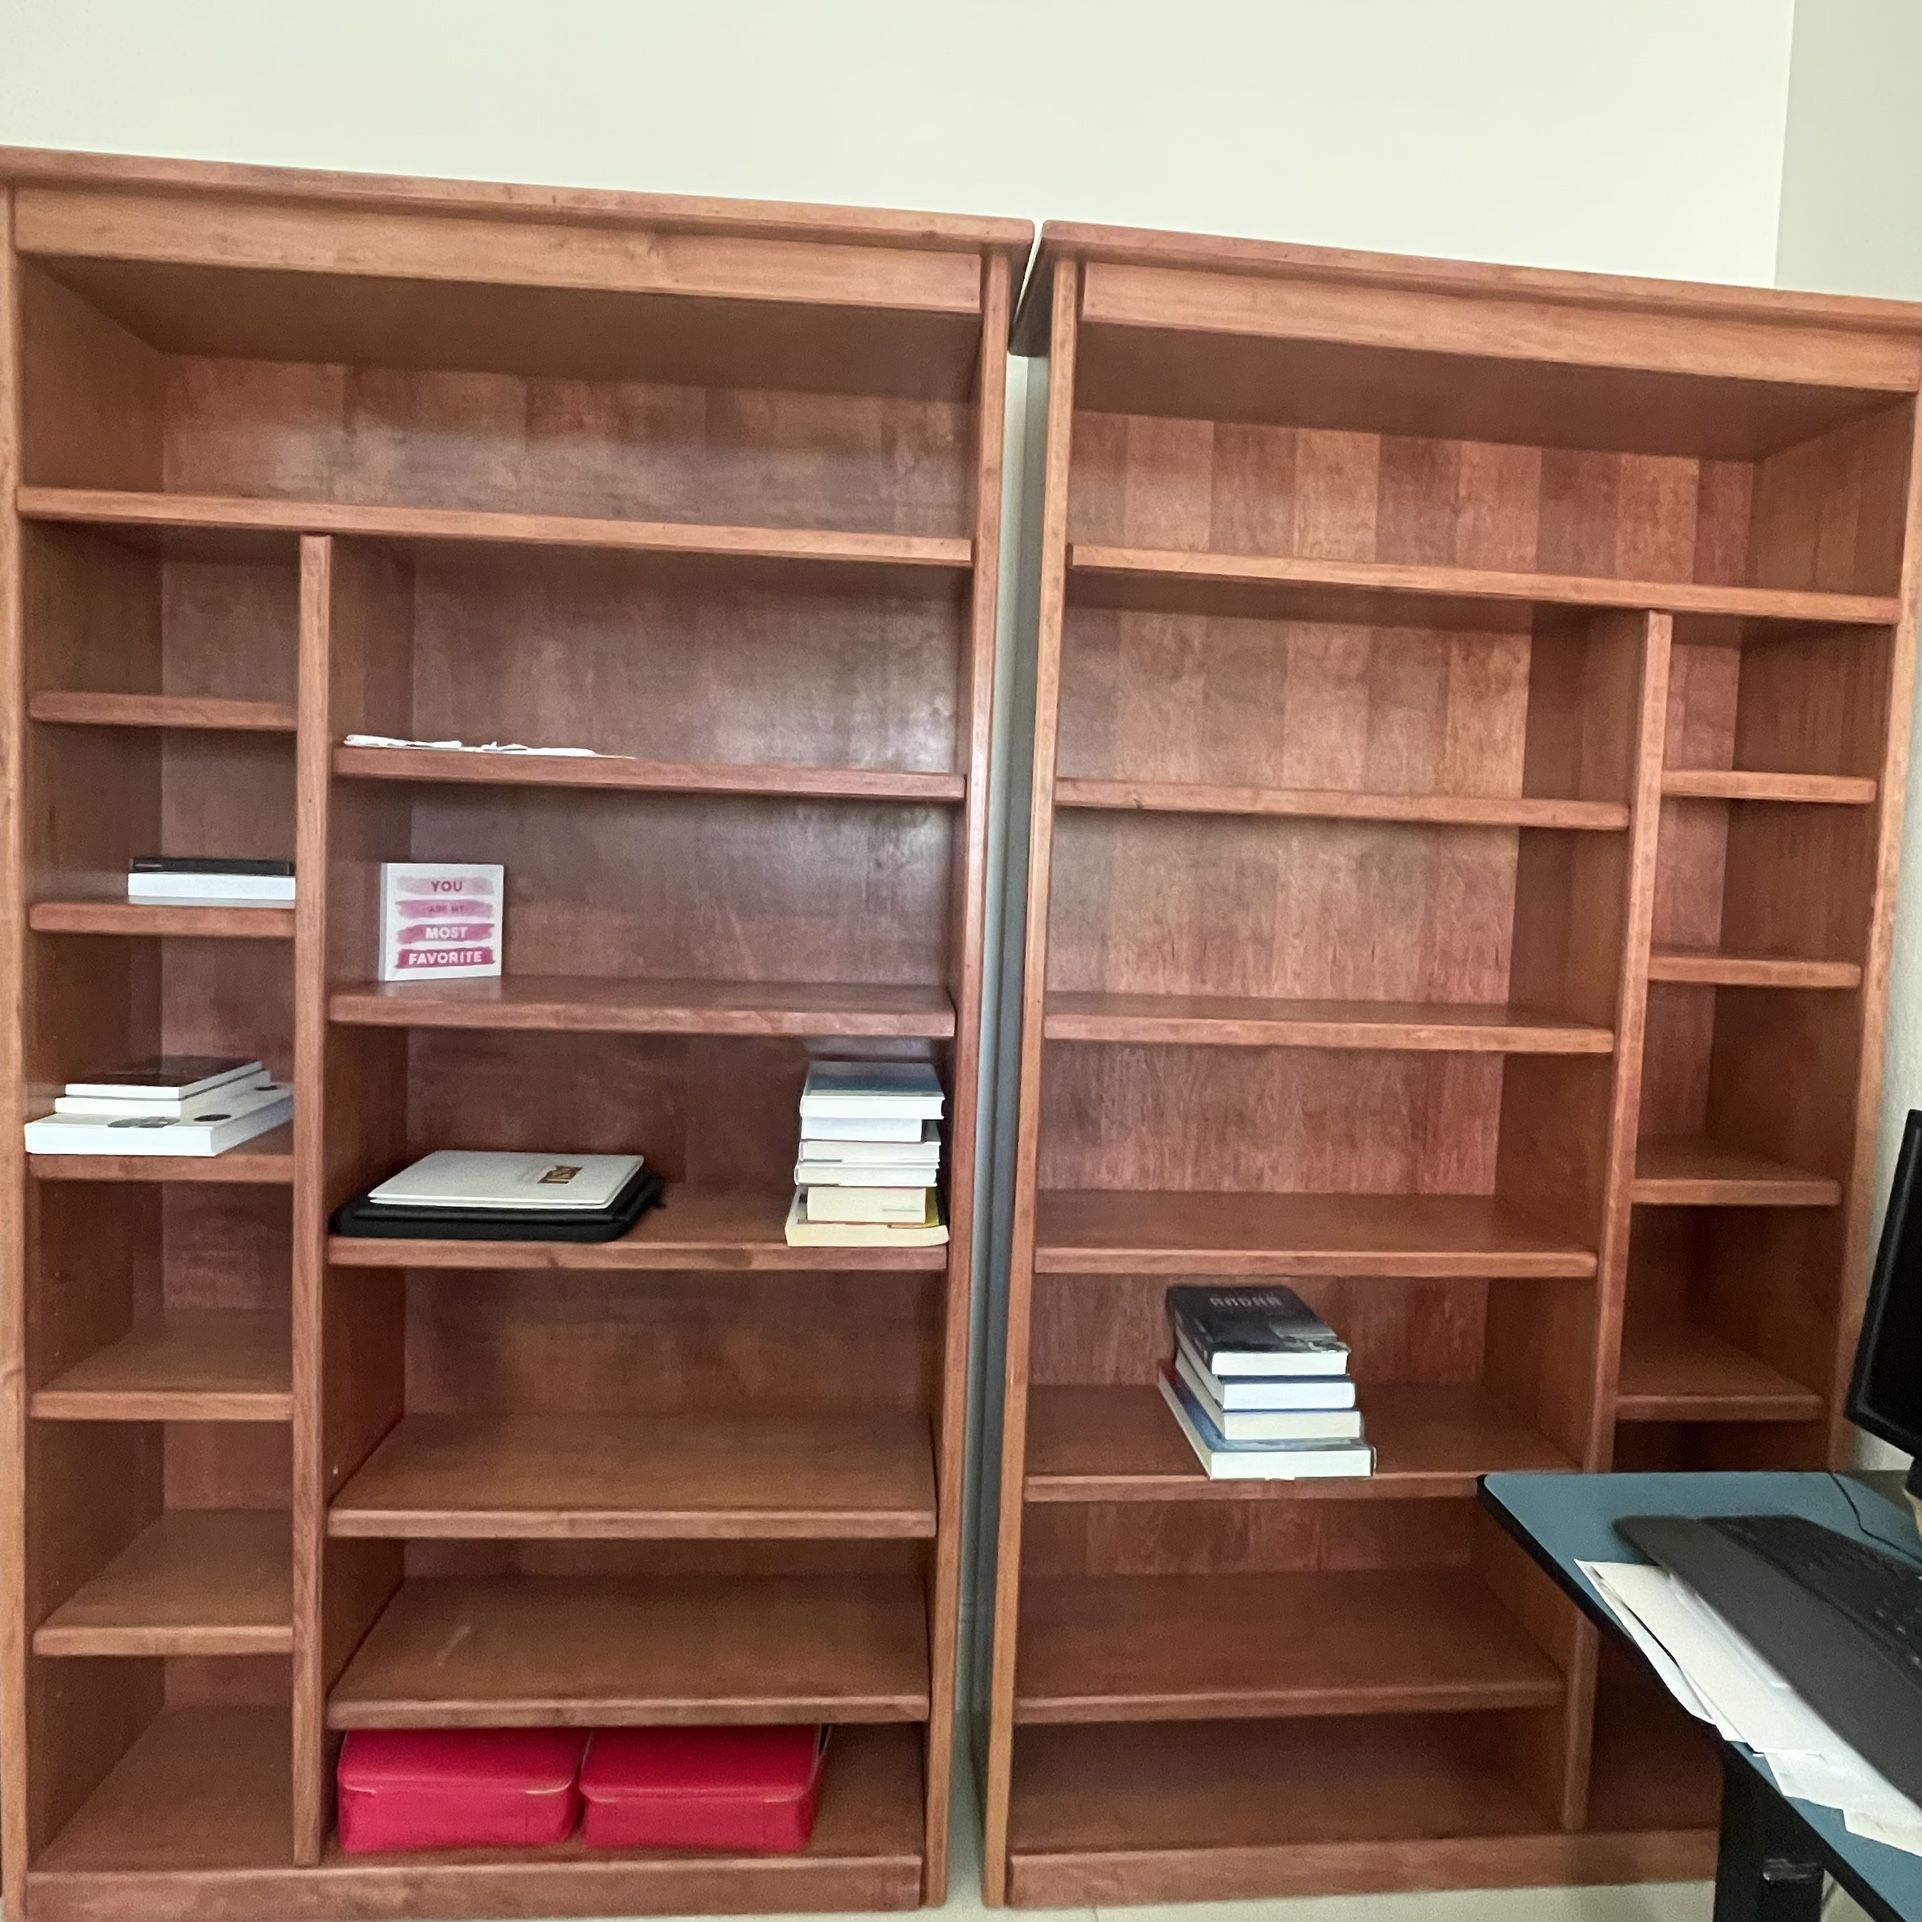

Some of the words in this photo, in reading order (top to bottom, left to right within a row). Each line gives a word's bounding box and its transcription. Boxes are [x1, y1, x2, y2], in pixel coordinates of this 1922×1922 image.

[431, 881, 463, 892] YOU
[425, 926, 468, 939] MOST
[408, 951, 483, 966] FAVORITE
